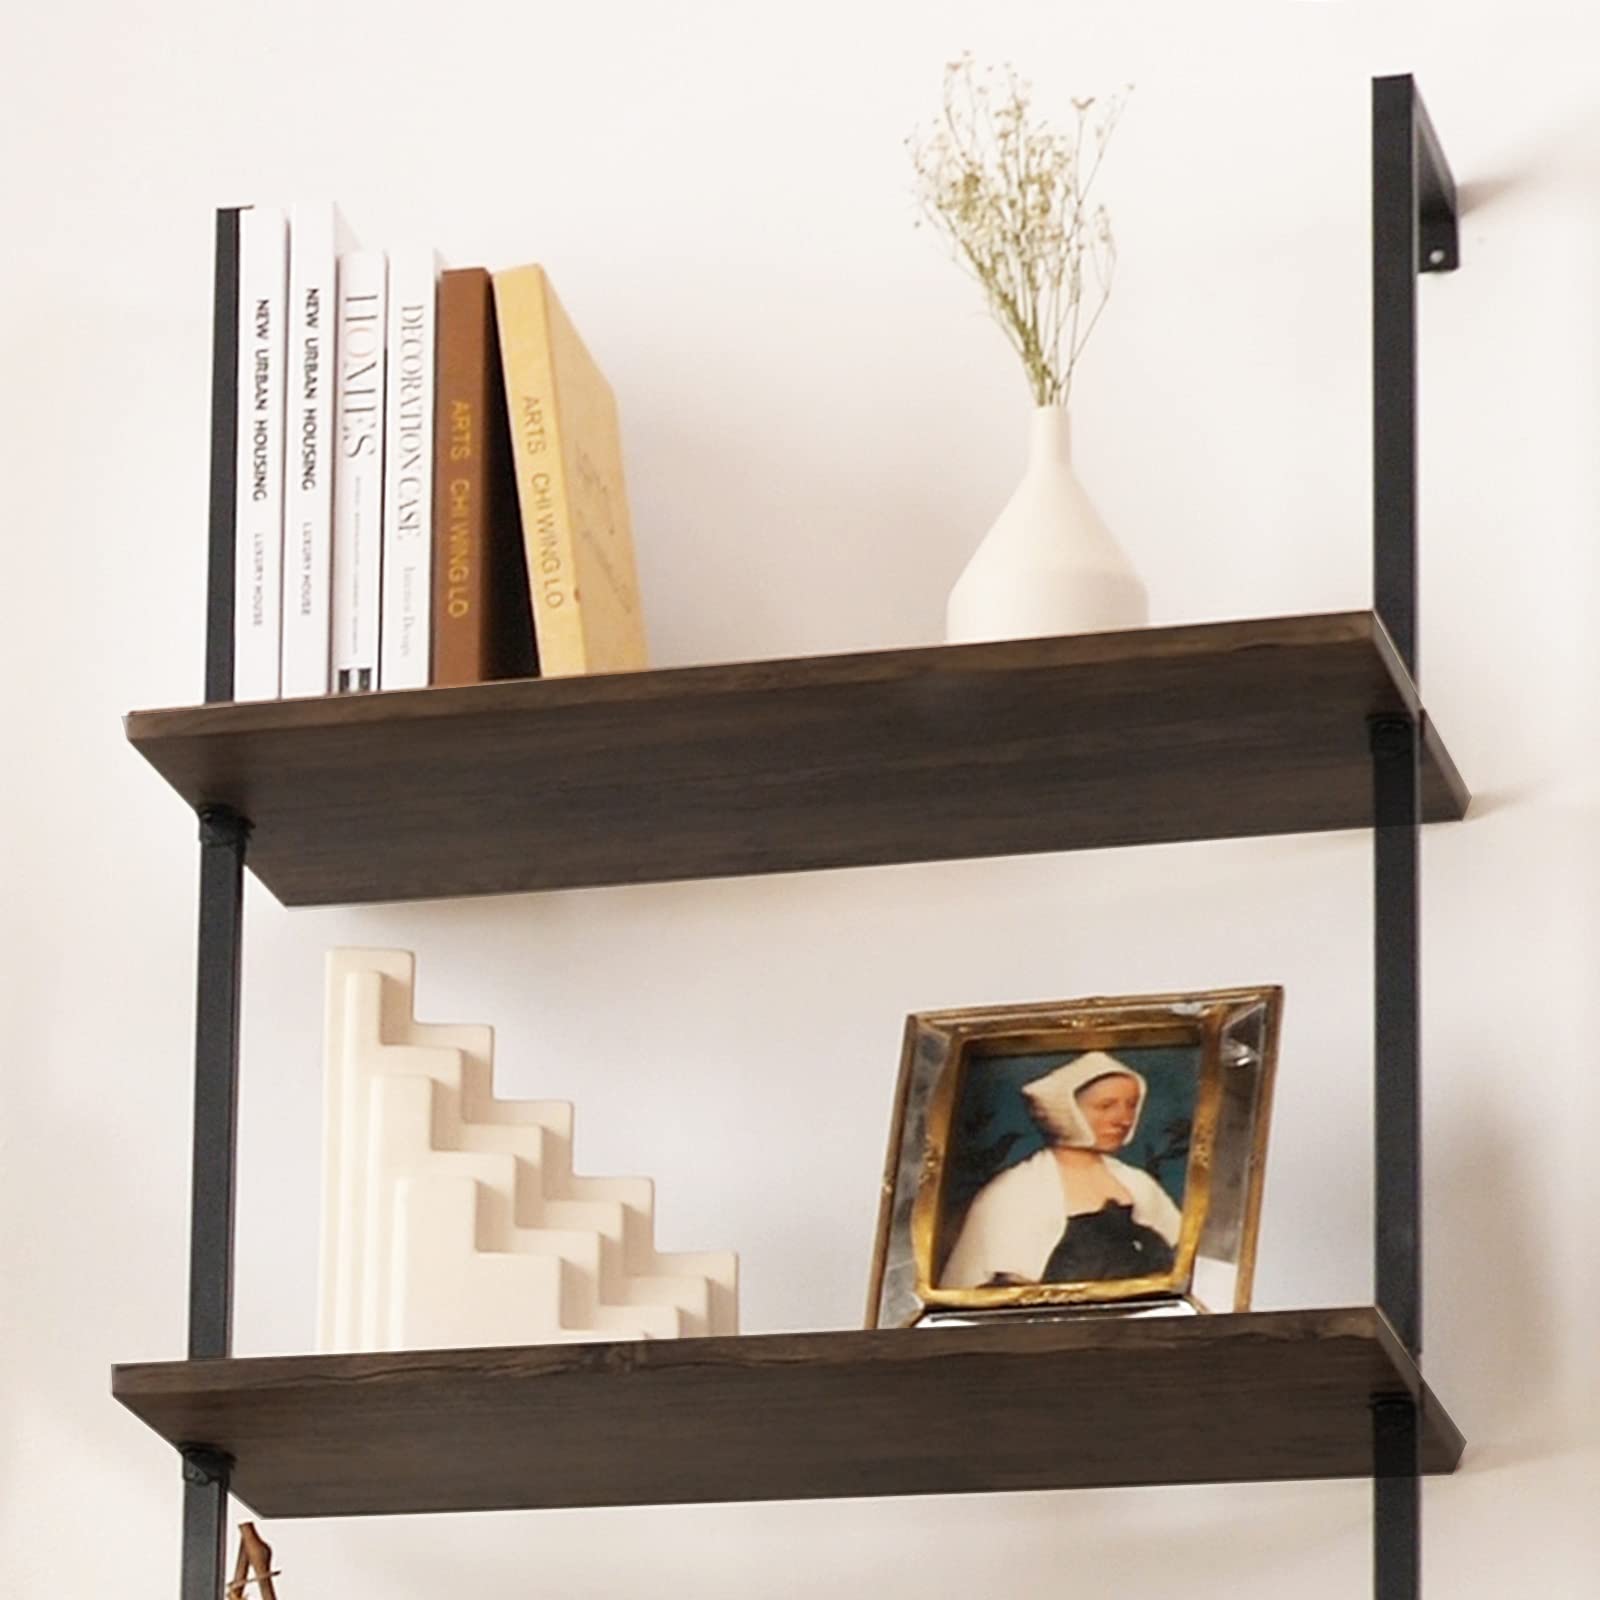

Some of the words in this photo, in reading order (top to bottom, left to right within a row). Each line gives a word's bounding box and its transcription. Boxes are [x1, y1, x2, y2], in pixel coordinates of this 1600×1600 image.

[256, 299, 270, 340] NEW
[305, 288, 320, 328] NEW
[254, 348, 269, 411] URBAN
[304, 337, 319, 399] URBAN
[343, 294, 378, 458] HOMES
[400, 304, 424, 470] DECORATION
[302, 408, 317, 491] HOUSING
[450, 400, 471, 460] ARTS
[523, 396, 547, 455] ARTS
[253, 420, 268, 502] HOUSING
[397, 477, 421, 541] CASE
